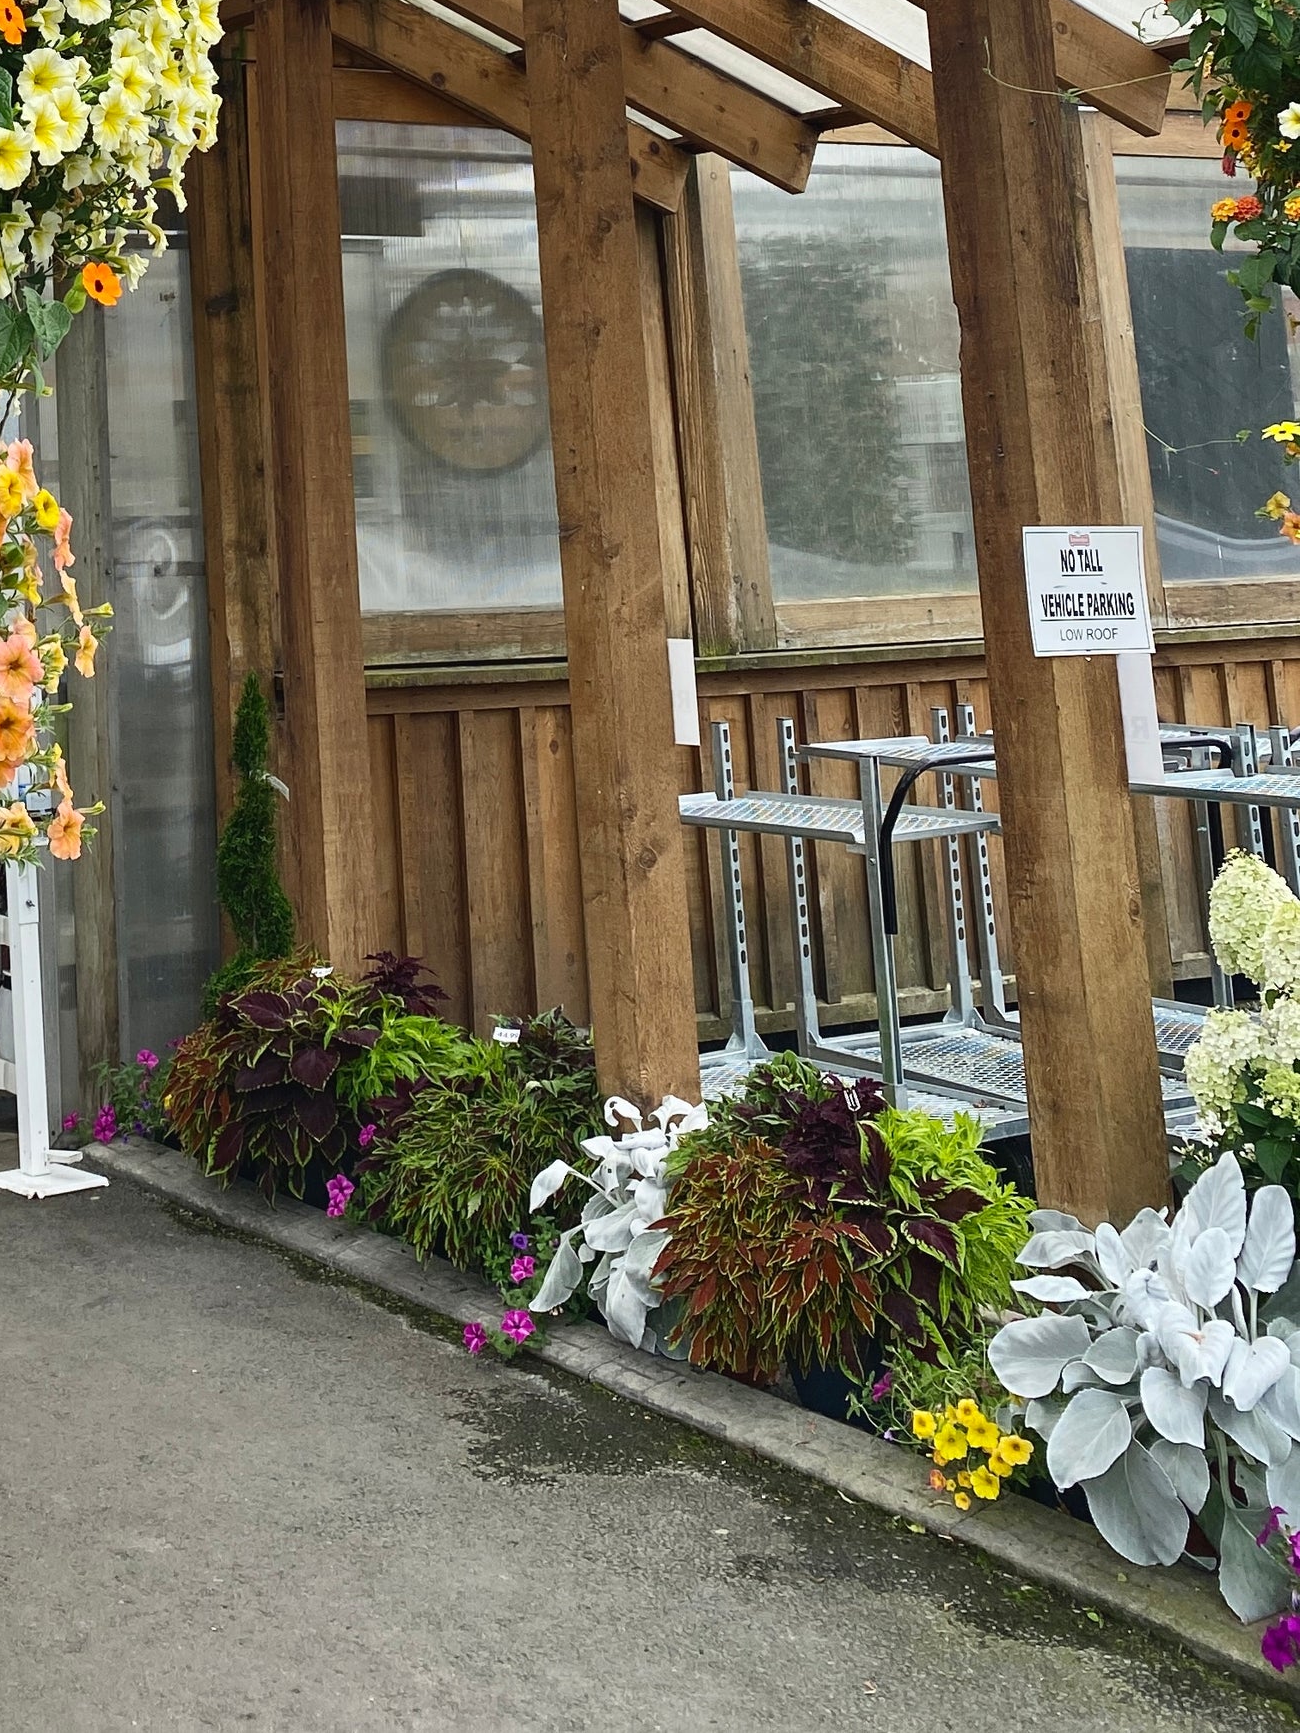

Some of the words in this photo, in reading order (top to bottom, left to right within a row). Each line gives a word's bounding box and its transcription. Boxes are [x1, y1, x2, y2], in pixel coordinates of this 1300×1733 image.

[1060, 549, 1075, 572] NO
[1078, 549, 1103, 572] TALL
[1040, 593, 1085, 617] VEHICLE
[1087, 592, 1135, 616] PARKING
[1060, 629, 1084, 641] LOW
[1086, 628, 1119, 640] ROOF
